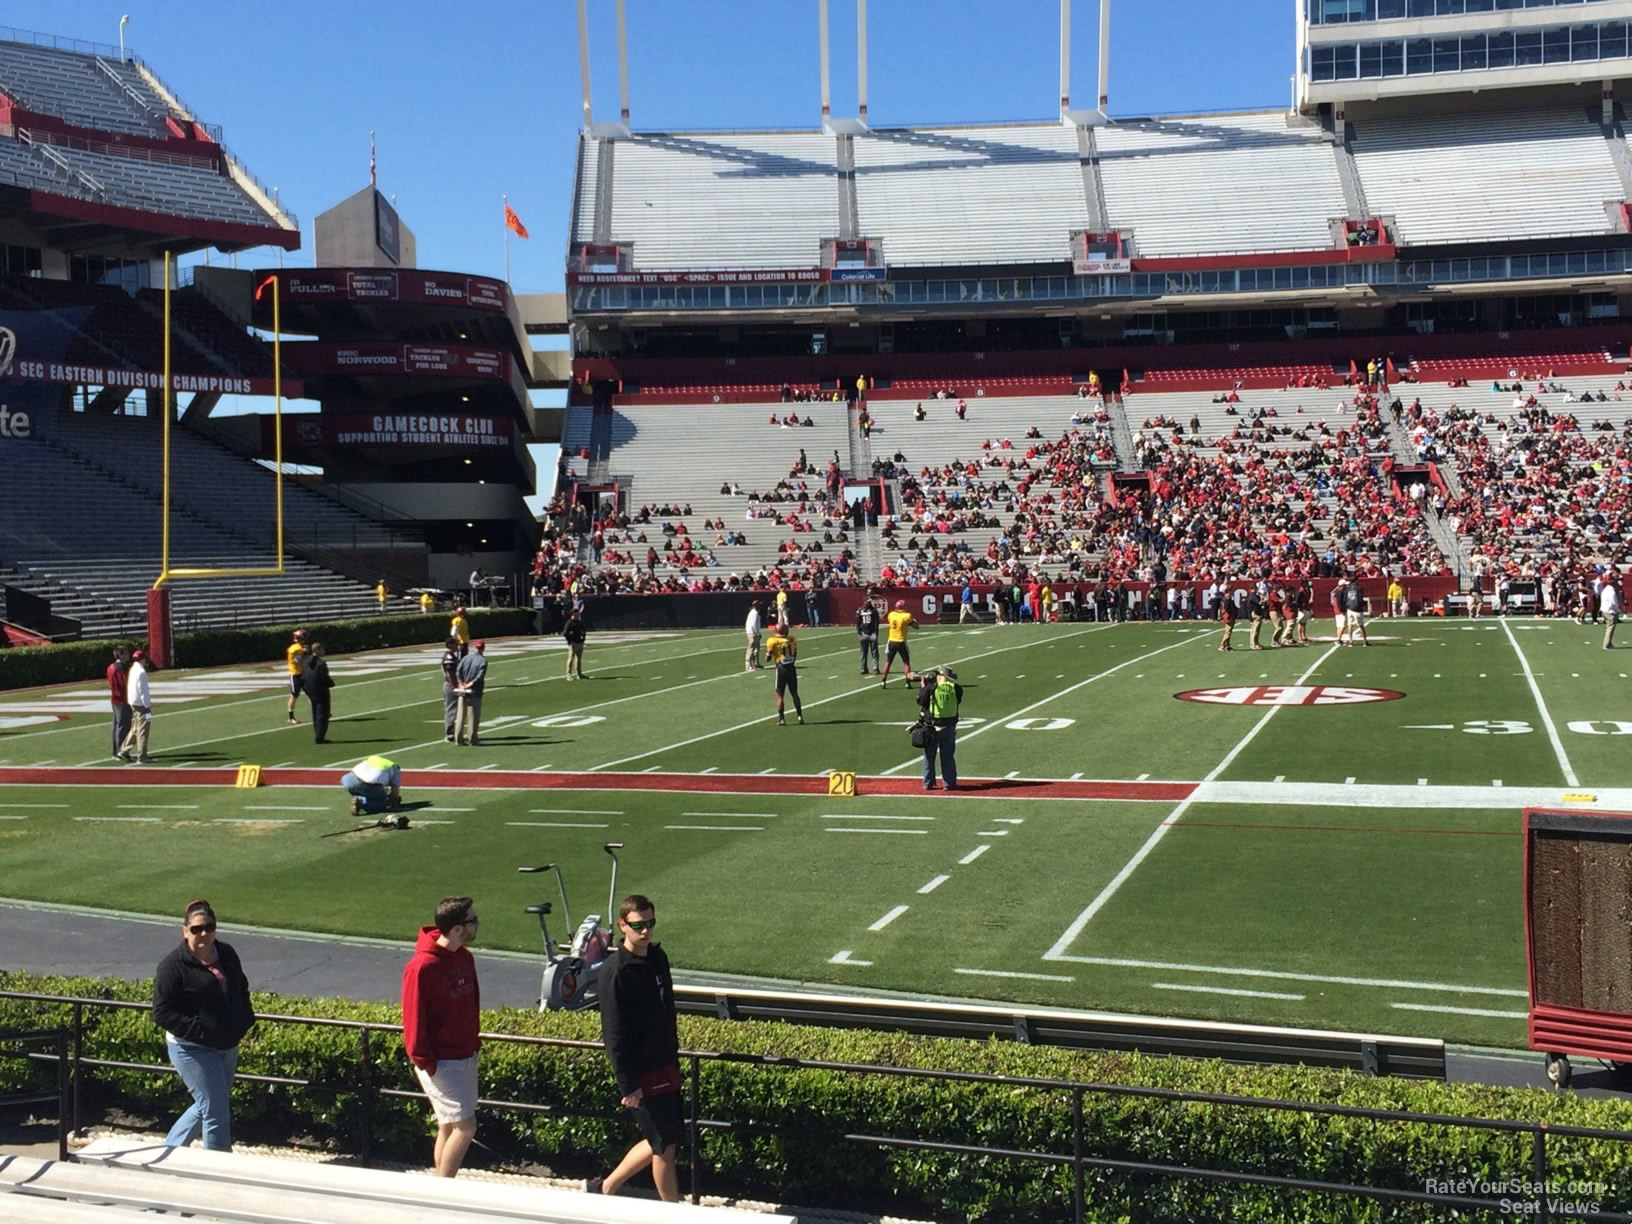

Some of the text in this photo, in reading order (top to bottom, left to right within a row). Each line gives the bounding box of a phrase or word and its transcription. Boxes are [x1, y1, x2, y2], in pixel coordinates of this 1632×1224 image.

[597, 274, 640, 283] ASSISTANCE?
[643, 274, 657, 282] TEXT
[717, 274, 737, 282] ISSUE
[738, 273, 752, 281] AND
[754, 273, 785, 281] LOCATION
[788, 272, 796, 280] TO
[424, 288, 462, 298] DAVIES
[337, 356, 397, 365] NORWOOD
[20, 361, 44, 378] SEC
[50, 364, 103, 384] EASTERN
[107, 369, 166, 389] DIVISION
[173, 374, 251, 393] CHAMPIONS
[373, 416, 494, 434] GAMECOCK CLUB
[338, 432, 398, 444] SUPPORTING
[401, 432, 441, 444] STUDENT
[444, 433, 479, 445] ATHLETES
[862, 615, 872, 624] 19
[241, 768, 257, 787] 10
[830, 773, 854, 795] 20
